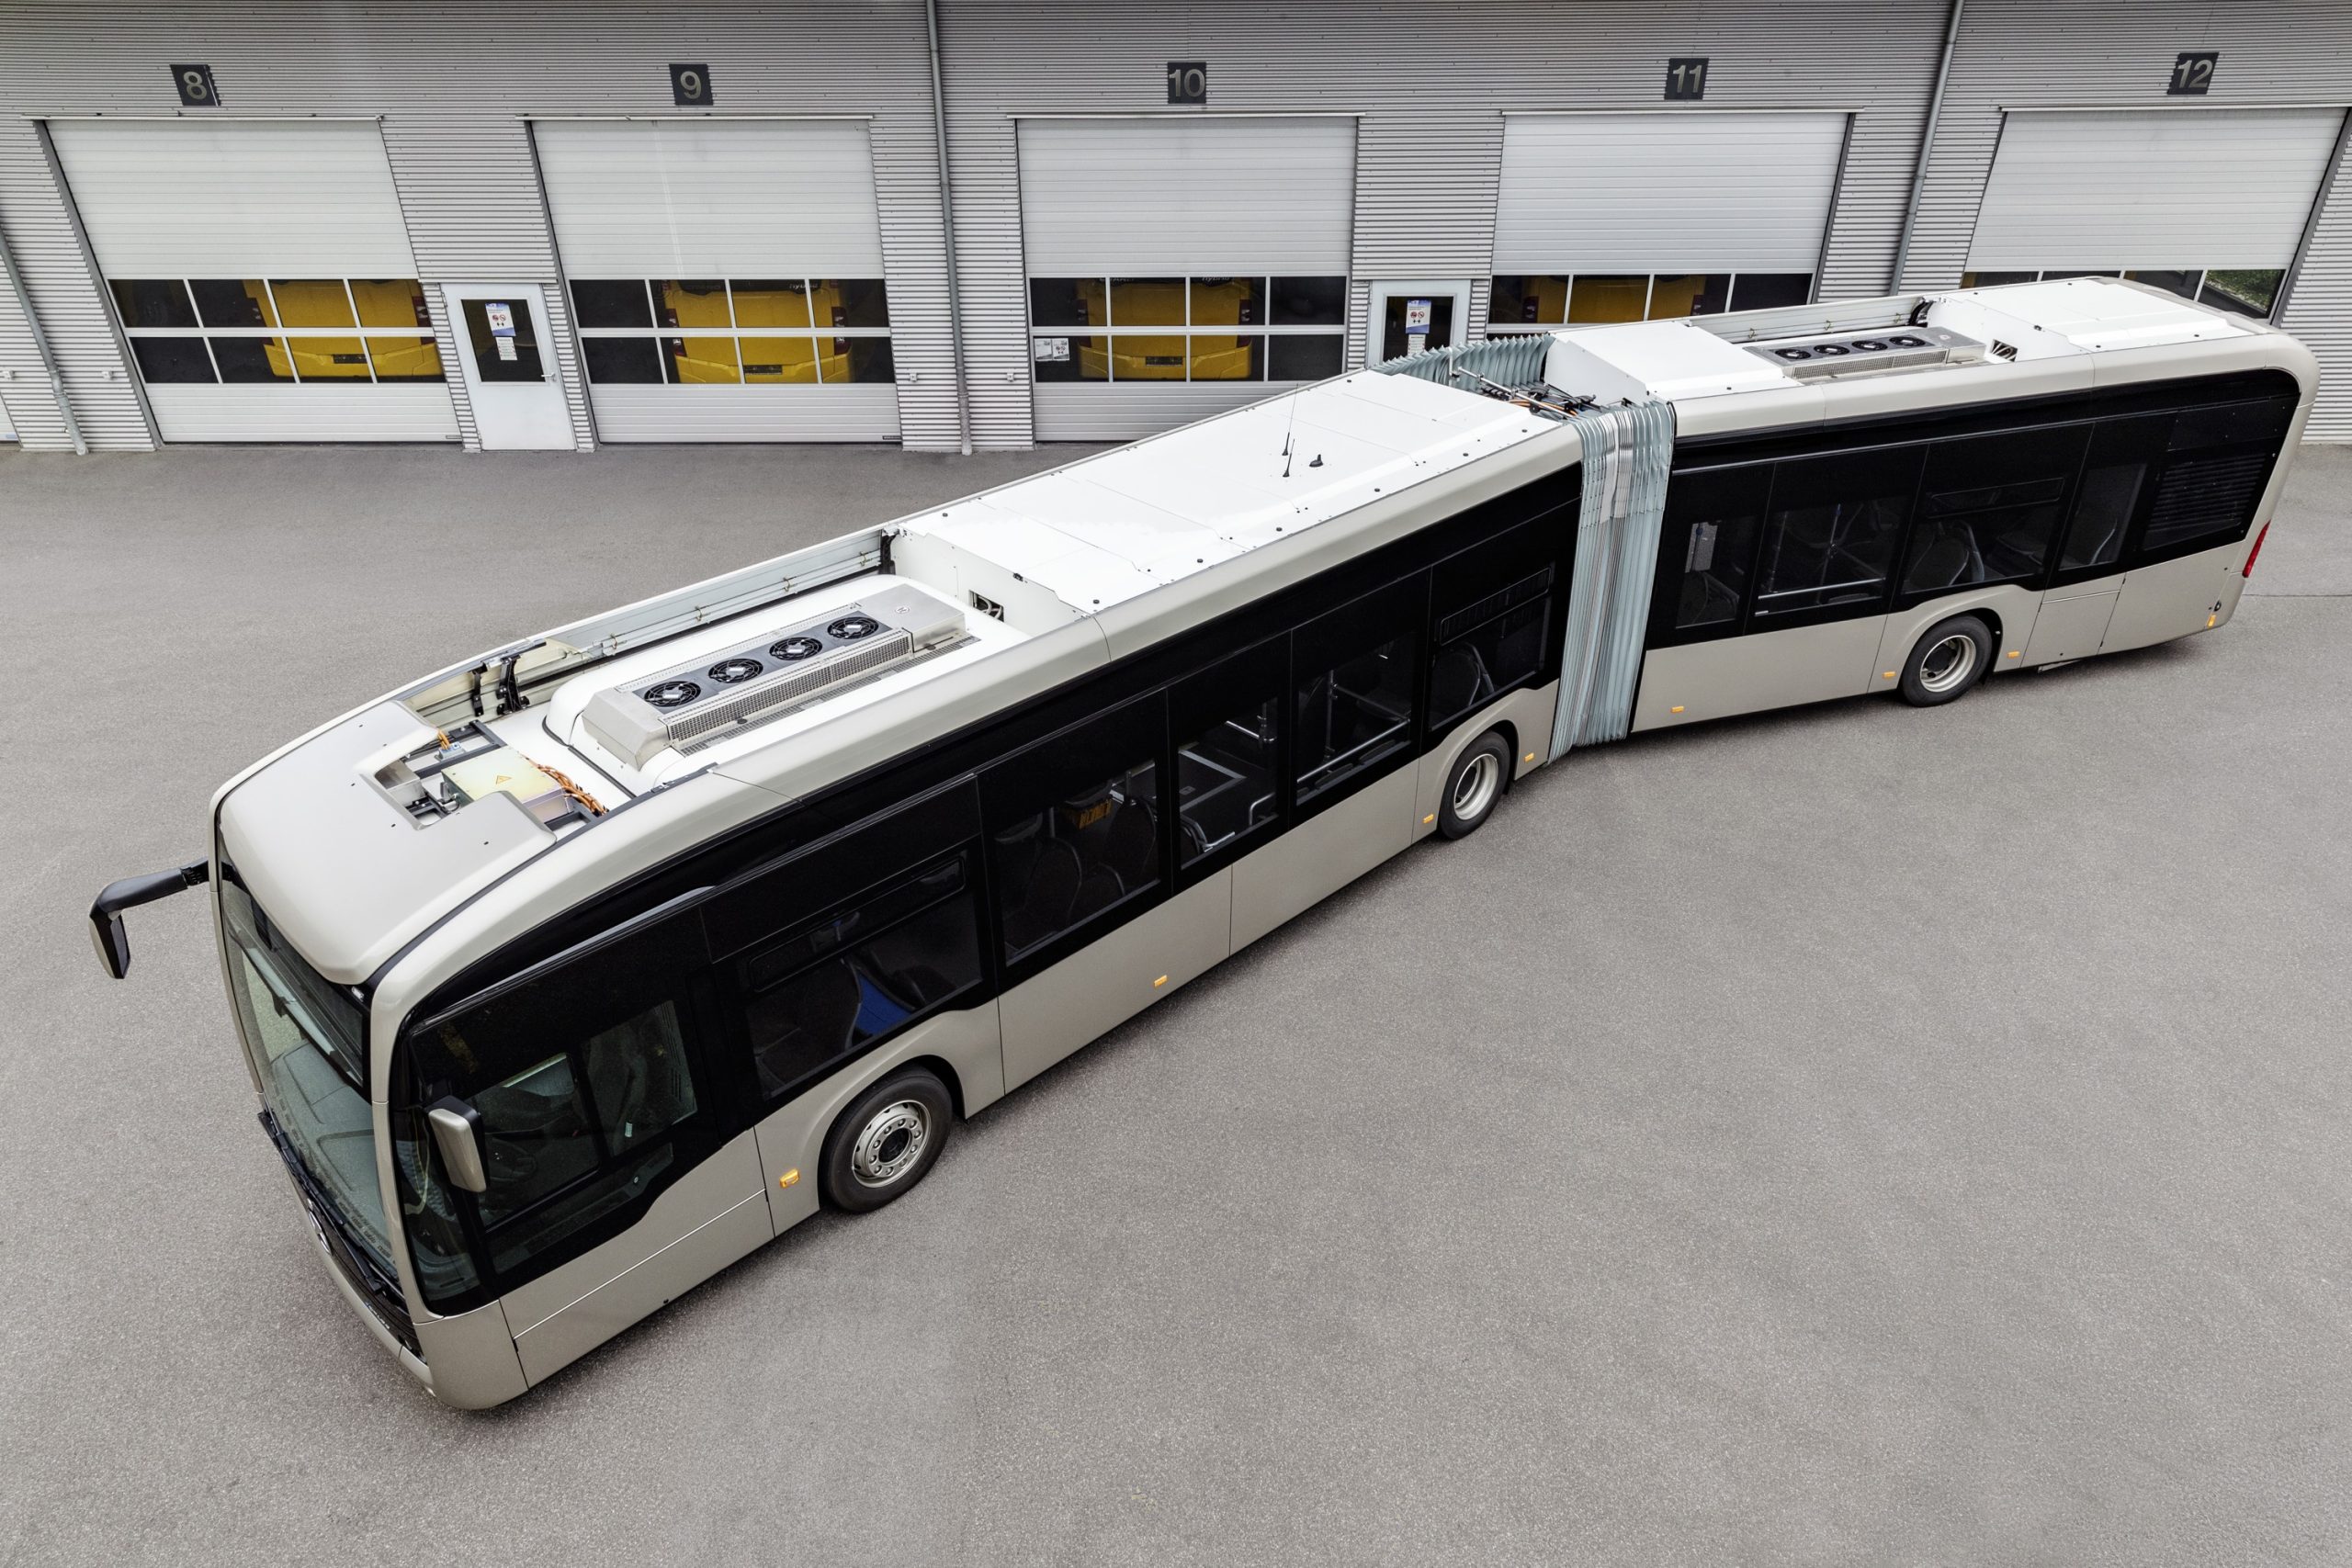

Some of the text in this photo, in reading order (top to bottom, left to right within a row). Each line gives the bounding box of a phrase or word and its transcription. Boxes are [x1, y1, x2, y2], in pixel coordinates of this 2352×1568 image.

[183, 71, 208, 100] 8
[680, 71, 702, 100] 9
[1169, 69, 1206, 97] 10
[1672, 64, 1703, 93] 11
[2177, 60, 2214, 88] 12
